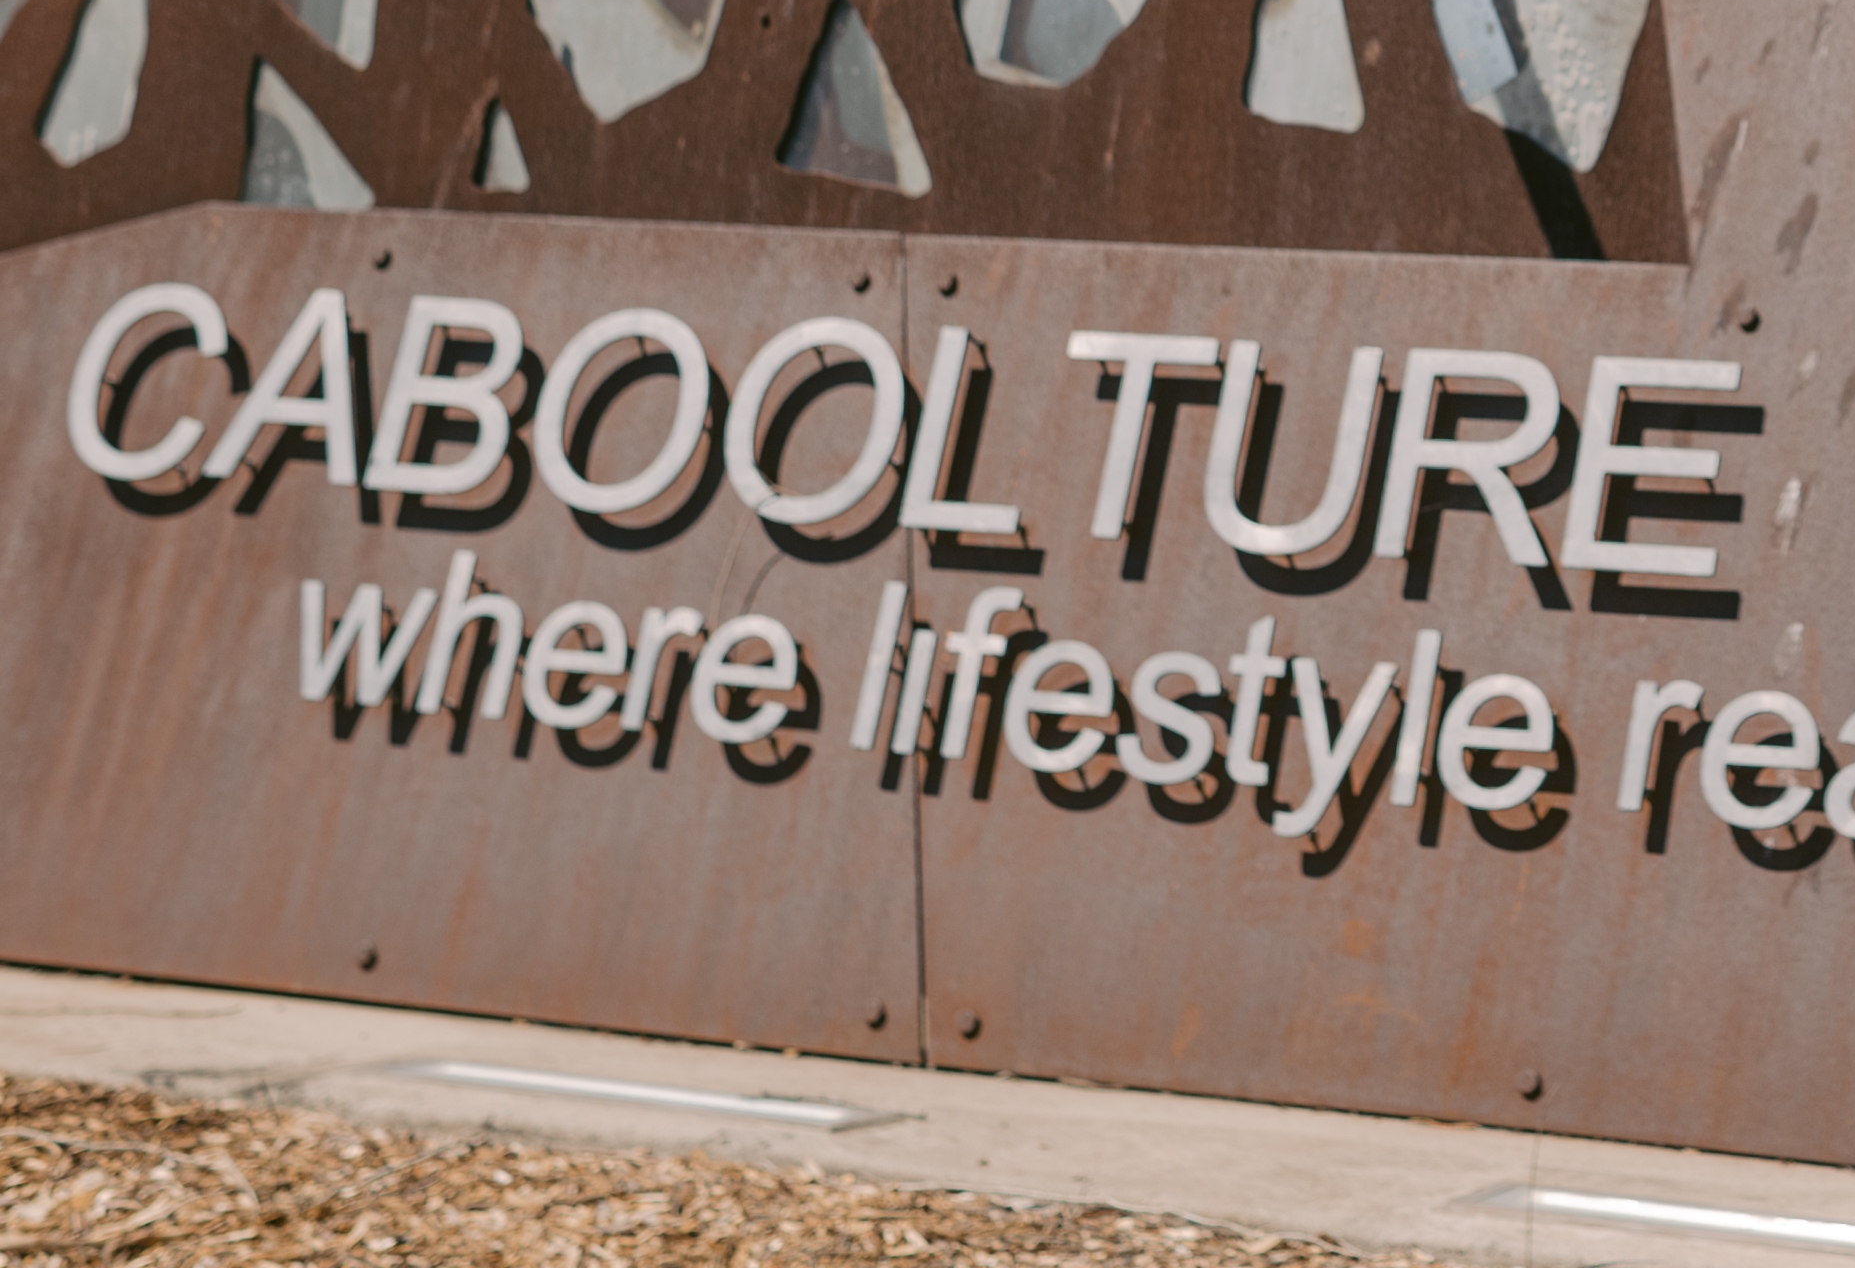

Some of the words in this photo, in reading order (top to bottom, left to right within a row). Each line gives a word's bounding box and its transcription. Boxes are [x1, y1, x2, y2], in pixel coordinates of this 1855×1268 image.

[66, 281, 1743, 577] CABOOLTURE
[300, 549, 799, 744] where
[849, 580, 1556, 838] lifestyle
